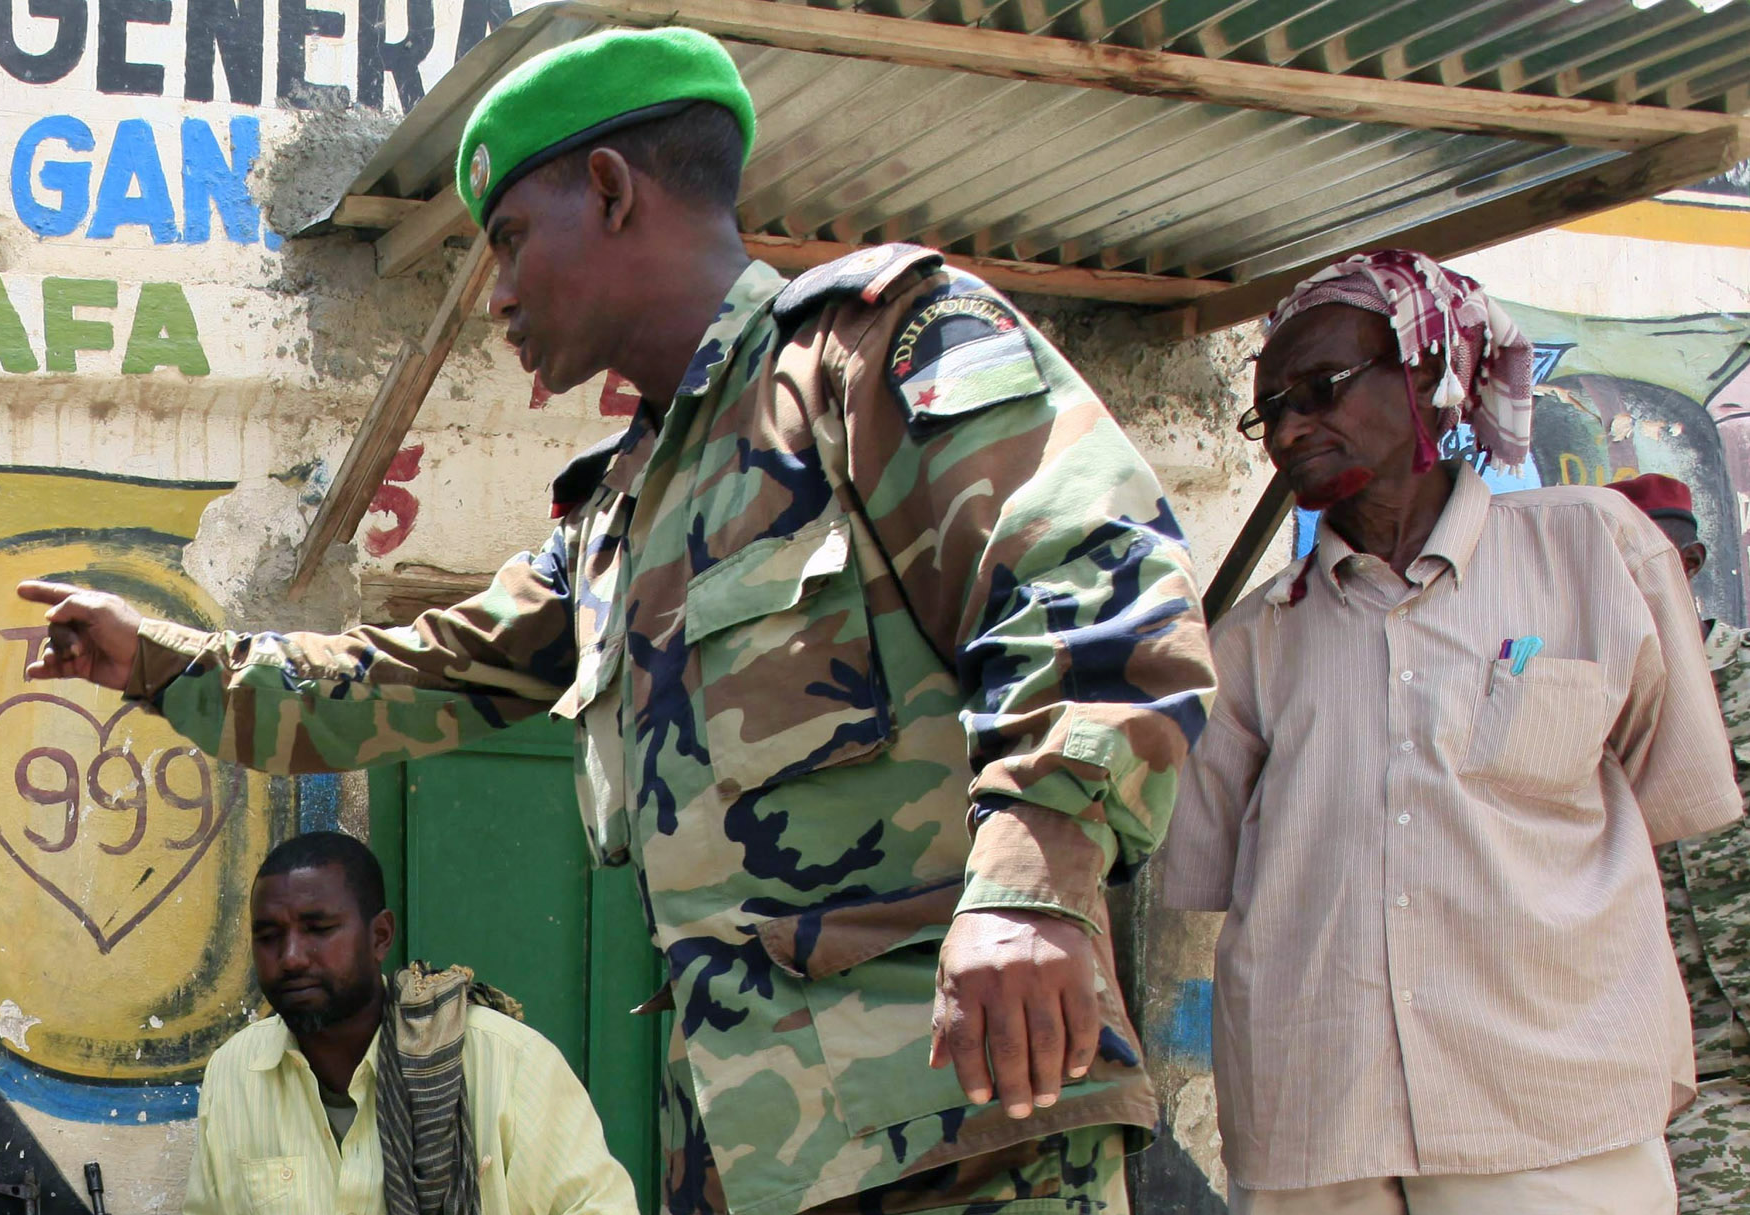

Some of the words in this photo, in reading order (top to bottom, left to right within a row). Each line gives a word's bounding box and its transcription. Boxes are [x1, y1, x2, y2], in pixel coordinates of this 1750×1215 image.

[10, 115, 284, 252] GAN
[891, 298, 1005, 369] DJIBOUTI
[14, 745, 214, 855] 999
